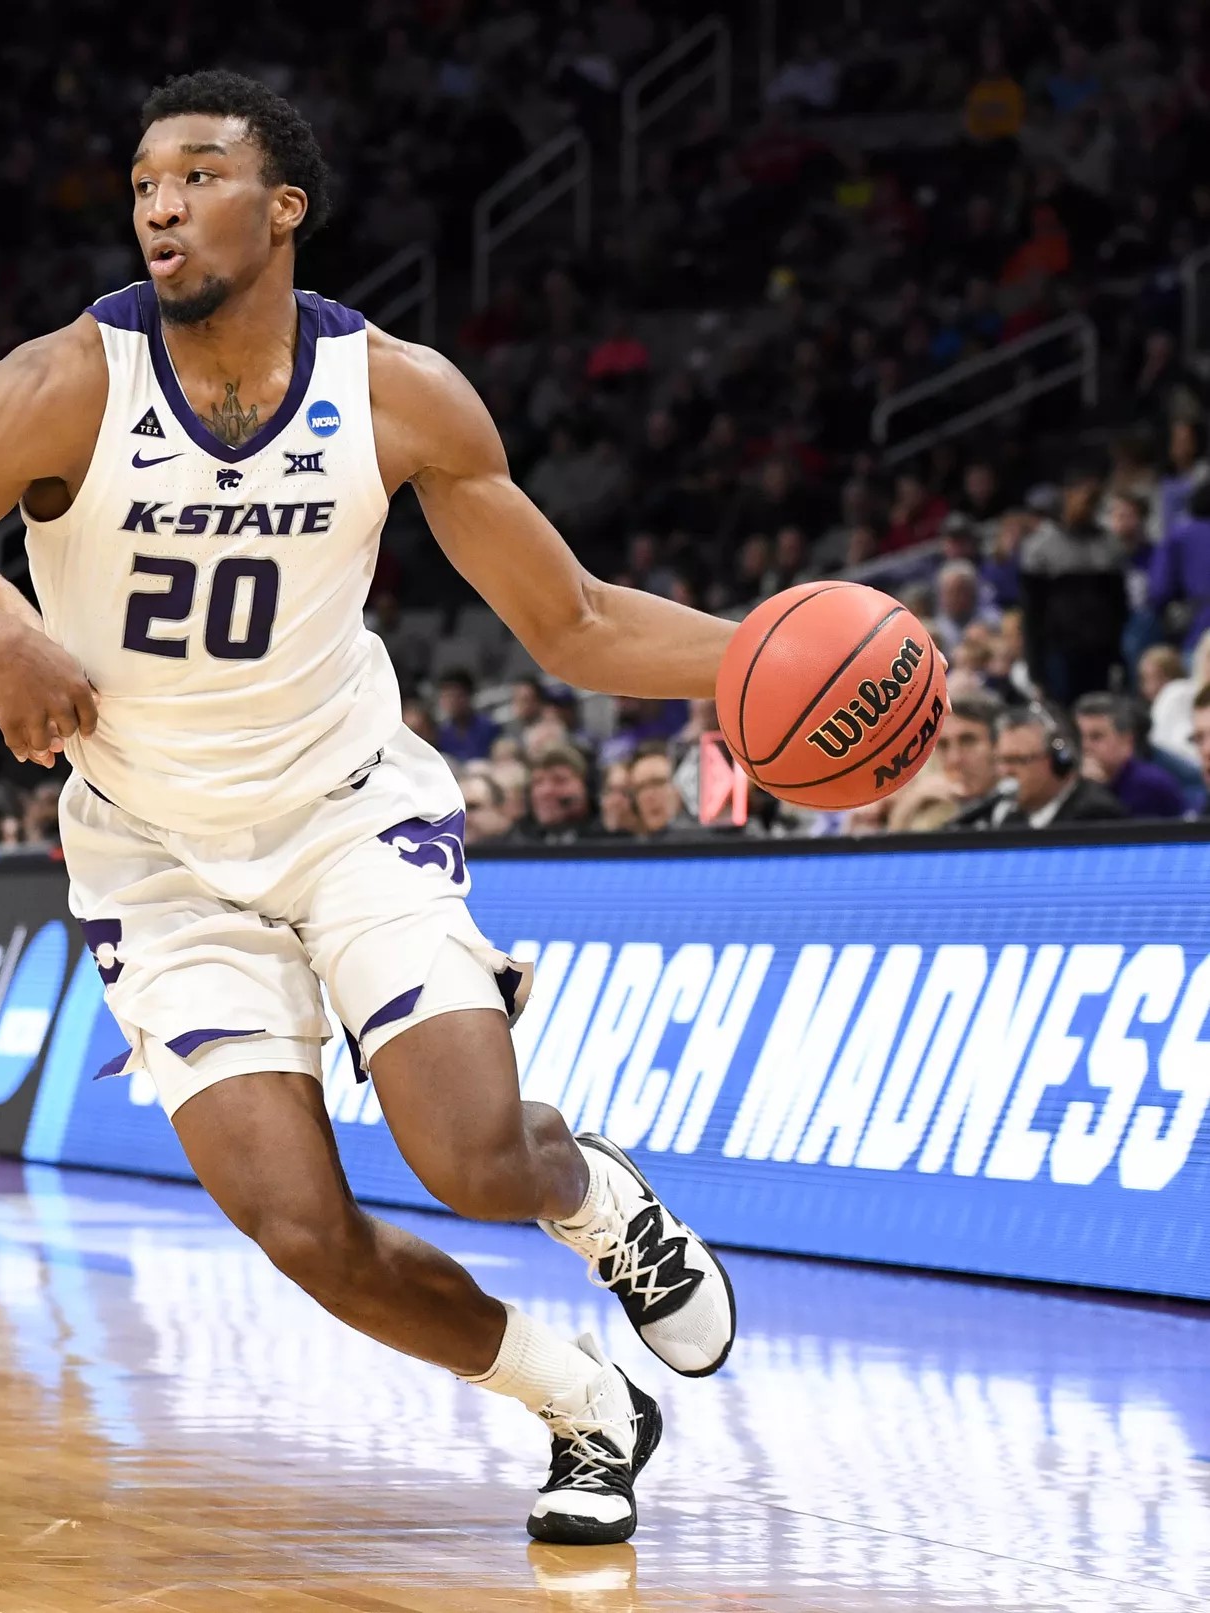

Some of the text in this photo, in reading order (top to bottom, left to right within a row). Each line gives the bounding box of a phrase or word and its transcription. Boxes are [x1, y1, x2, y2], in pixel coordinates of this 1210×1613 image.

[140, 425, 159, 435] TEX
[311, 416, 340, 428] NCAA
[118, 500, 337, 537] K-STATE
[121, 552, 282, 660] 20
[805, 636, 925, 760] Wilson
[873, 695, 944, 789] NCAA
[722, 943, 1210, 1192] MADNESS
